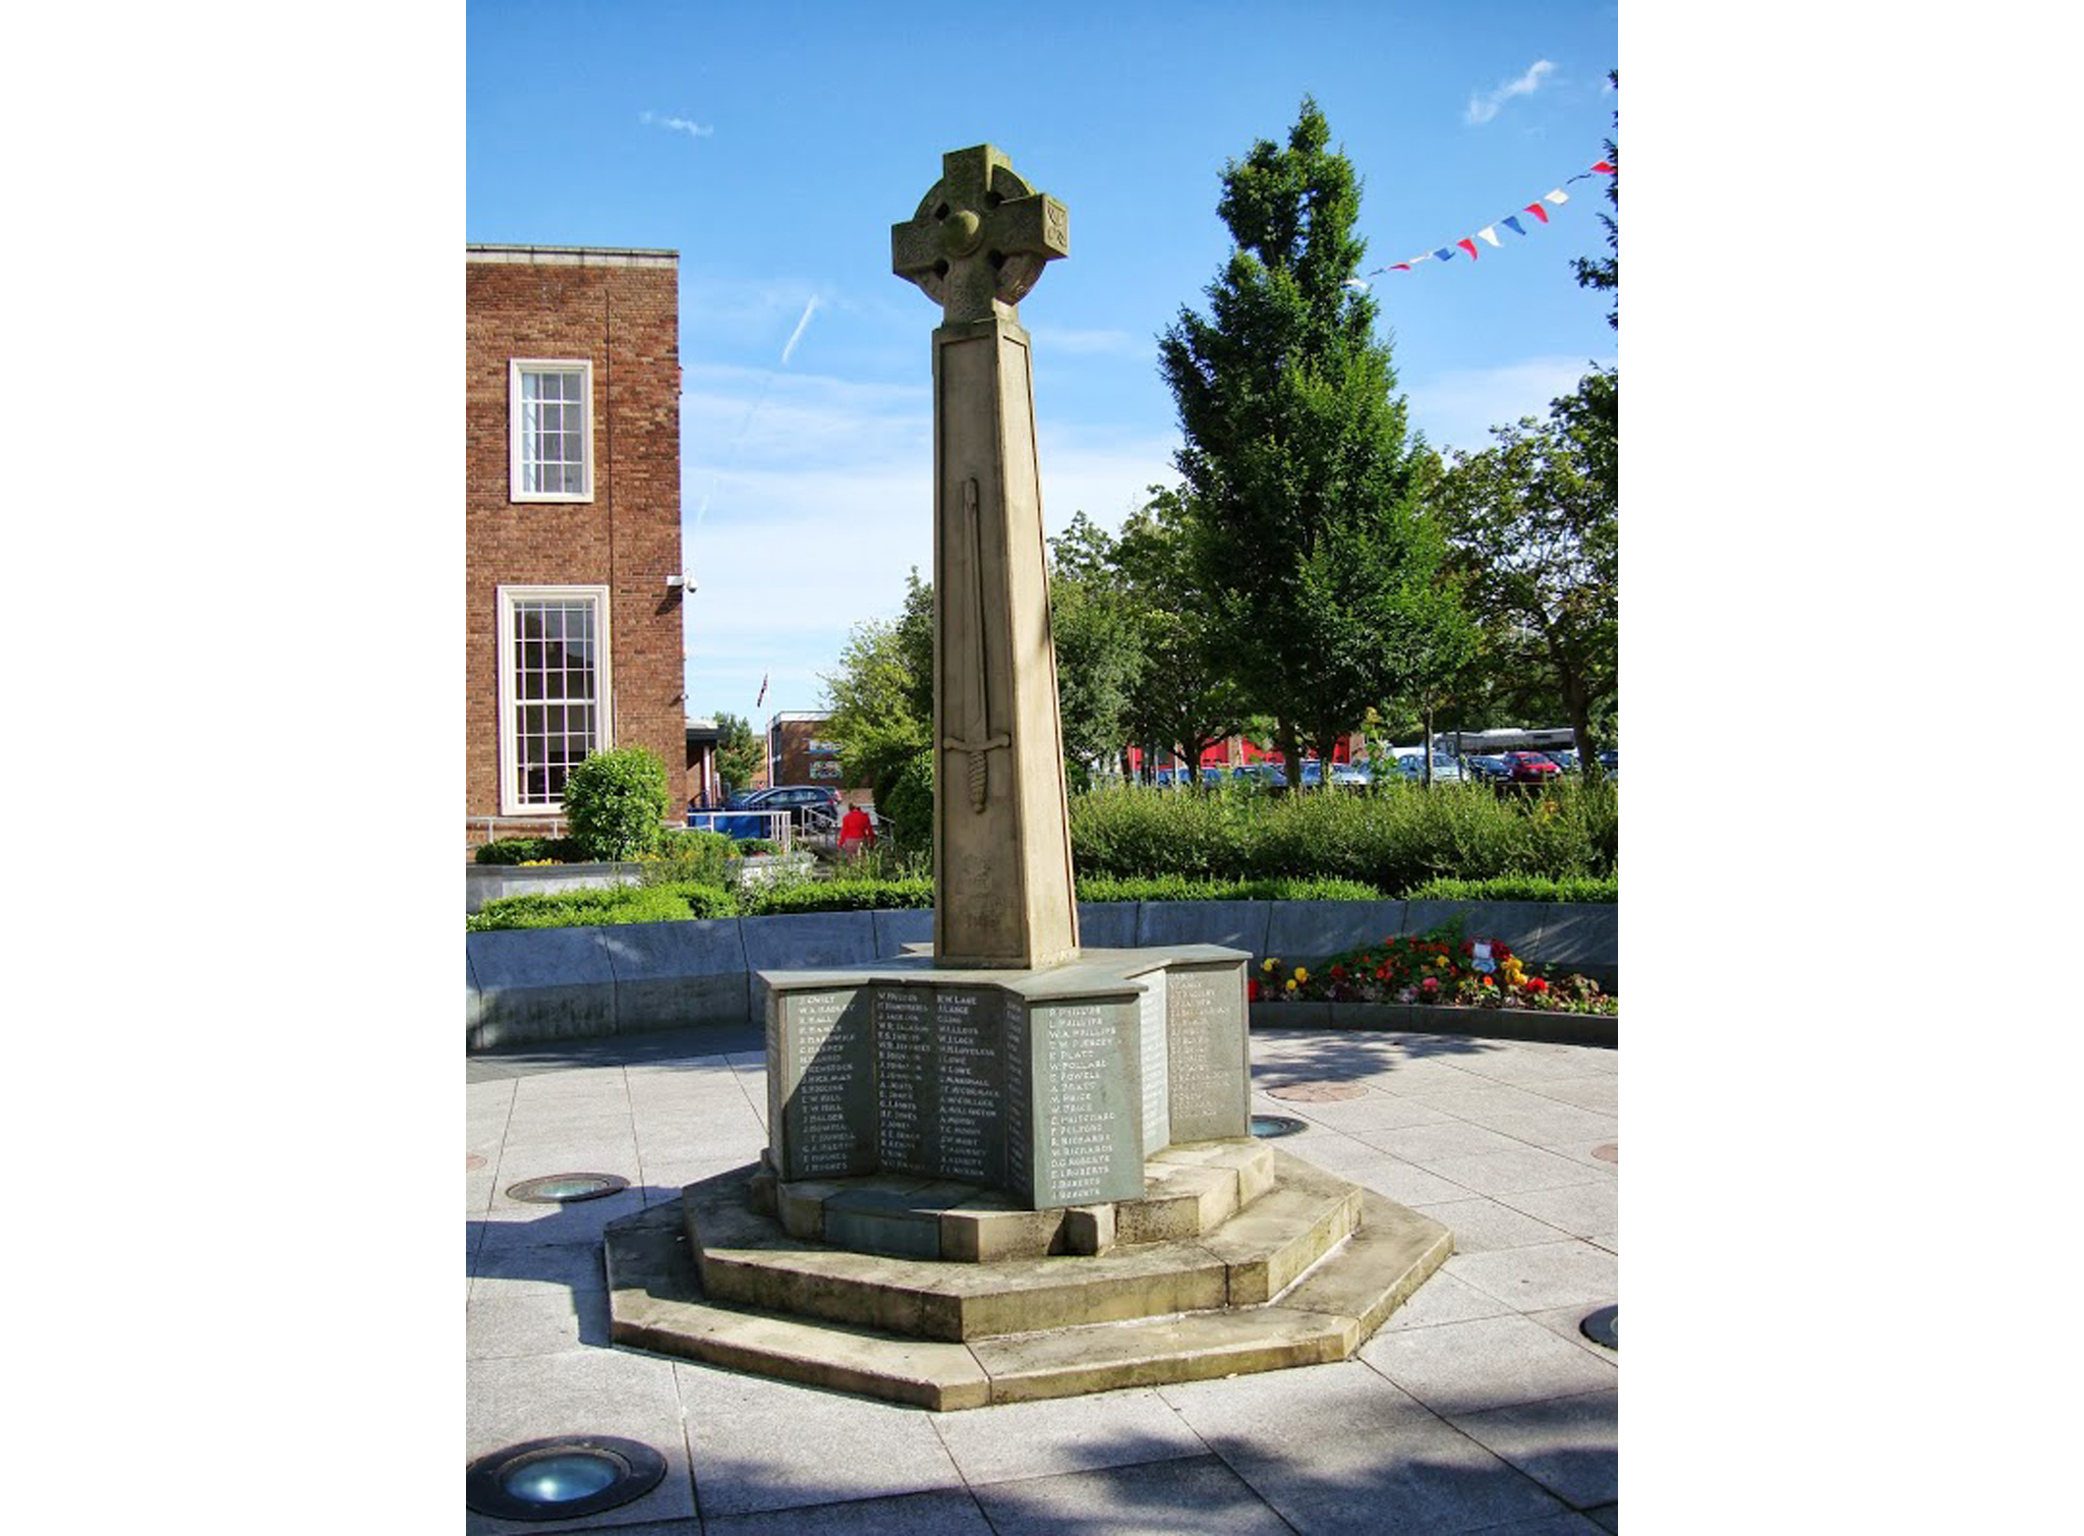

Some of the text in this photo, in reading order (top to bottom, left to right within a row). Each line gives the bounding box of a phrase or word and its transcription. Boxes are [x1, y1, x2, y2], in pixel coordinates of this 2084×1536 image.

[1058, 1006, 1102, 1017] PHILLIPS
[1058, 1016, 1103, 1028] PHILLIPS
[1072, 1025, 1117, 1037] PHILLIPS
[1061, 1071, 1101, 1081] POWELL
[1066, 1165, 1110, 1178] ROBERTS
